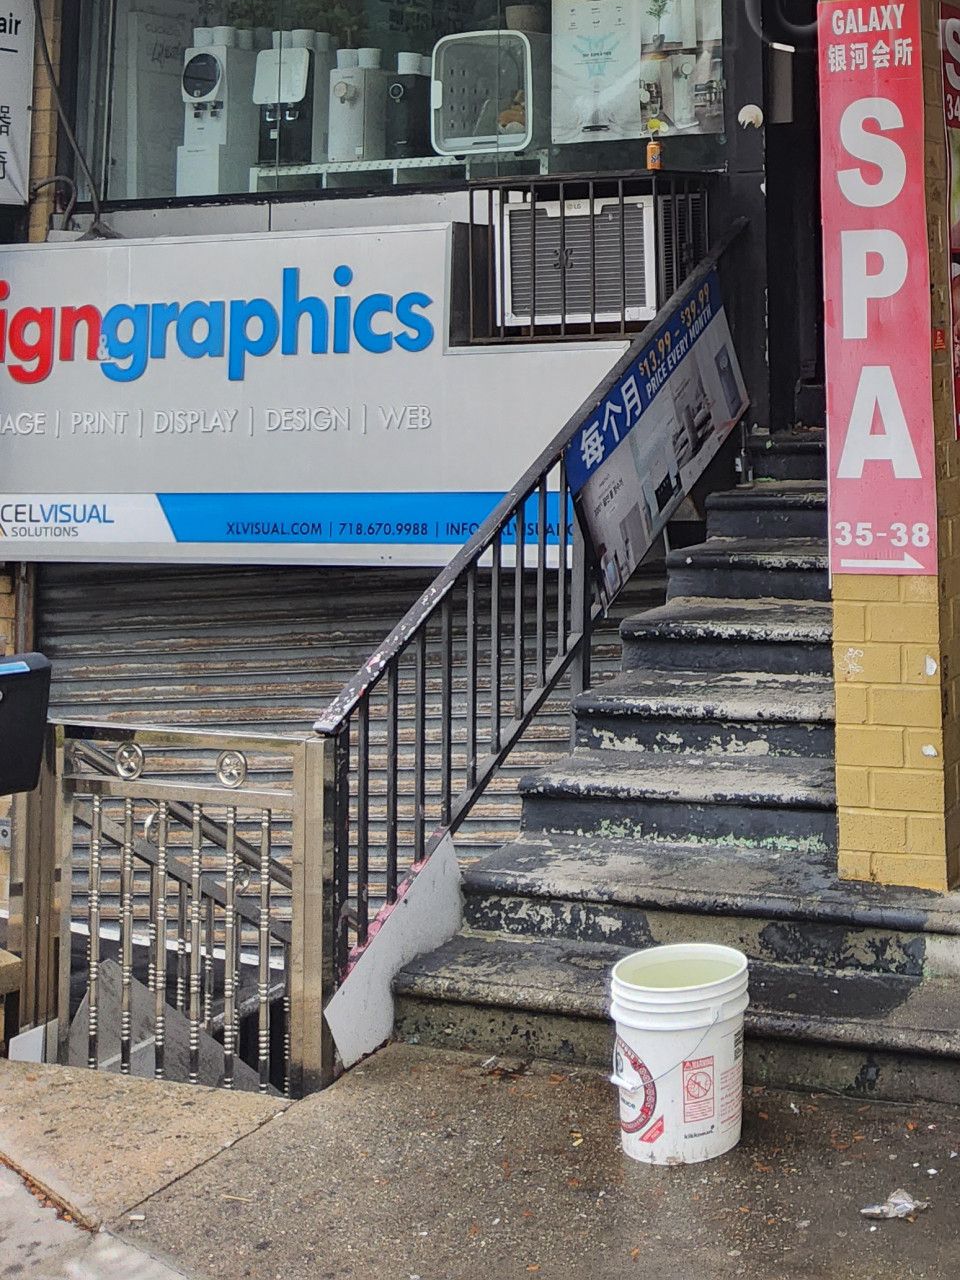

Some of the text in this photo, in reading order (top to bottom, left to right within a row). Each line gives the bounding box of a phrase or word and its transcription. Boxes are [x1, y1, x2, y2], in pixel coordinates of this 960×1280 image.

[832, 3, 905, 36] GALAXY
[827, 37, 913, 73] 银河会所
[836, 96, 922, 479] SPA
[638, 336, 671, 377] $13.99
[645, 365, 668, 400] PRICE
[666, 338, 690, 372] EVERY
[688, 304, 713, 343] MONTH
[71, 409, 129, 435] PRINT
[153, 408, 239, 434] DISPLAY
[265, 406, 350, 433] DESIGN
[378, 404, 432, 430] WEB
[580, 374, 642, 470] 每个月
[11, 526, 79, 538] SOLUTIONS
[226, 521, 322, 536] XLVISUAL.COM
[338, 521, 429, 536] 718.670.9988
[834, 521, 931, 548] 35-38
